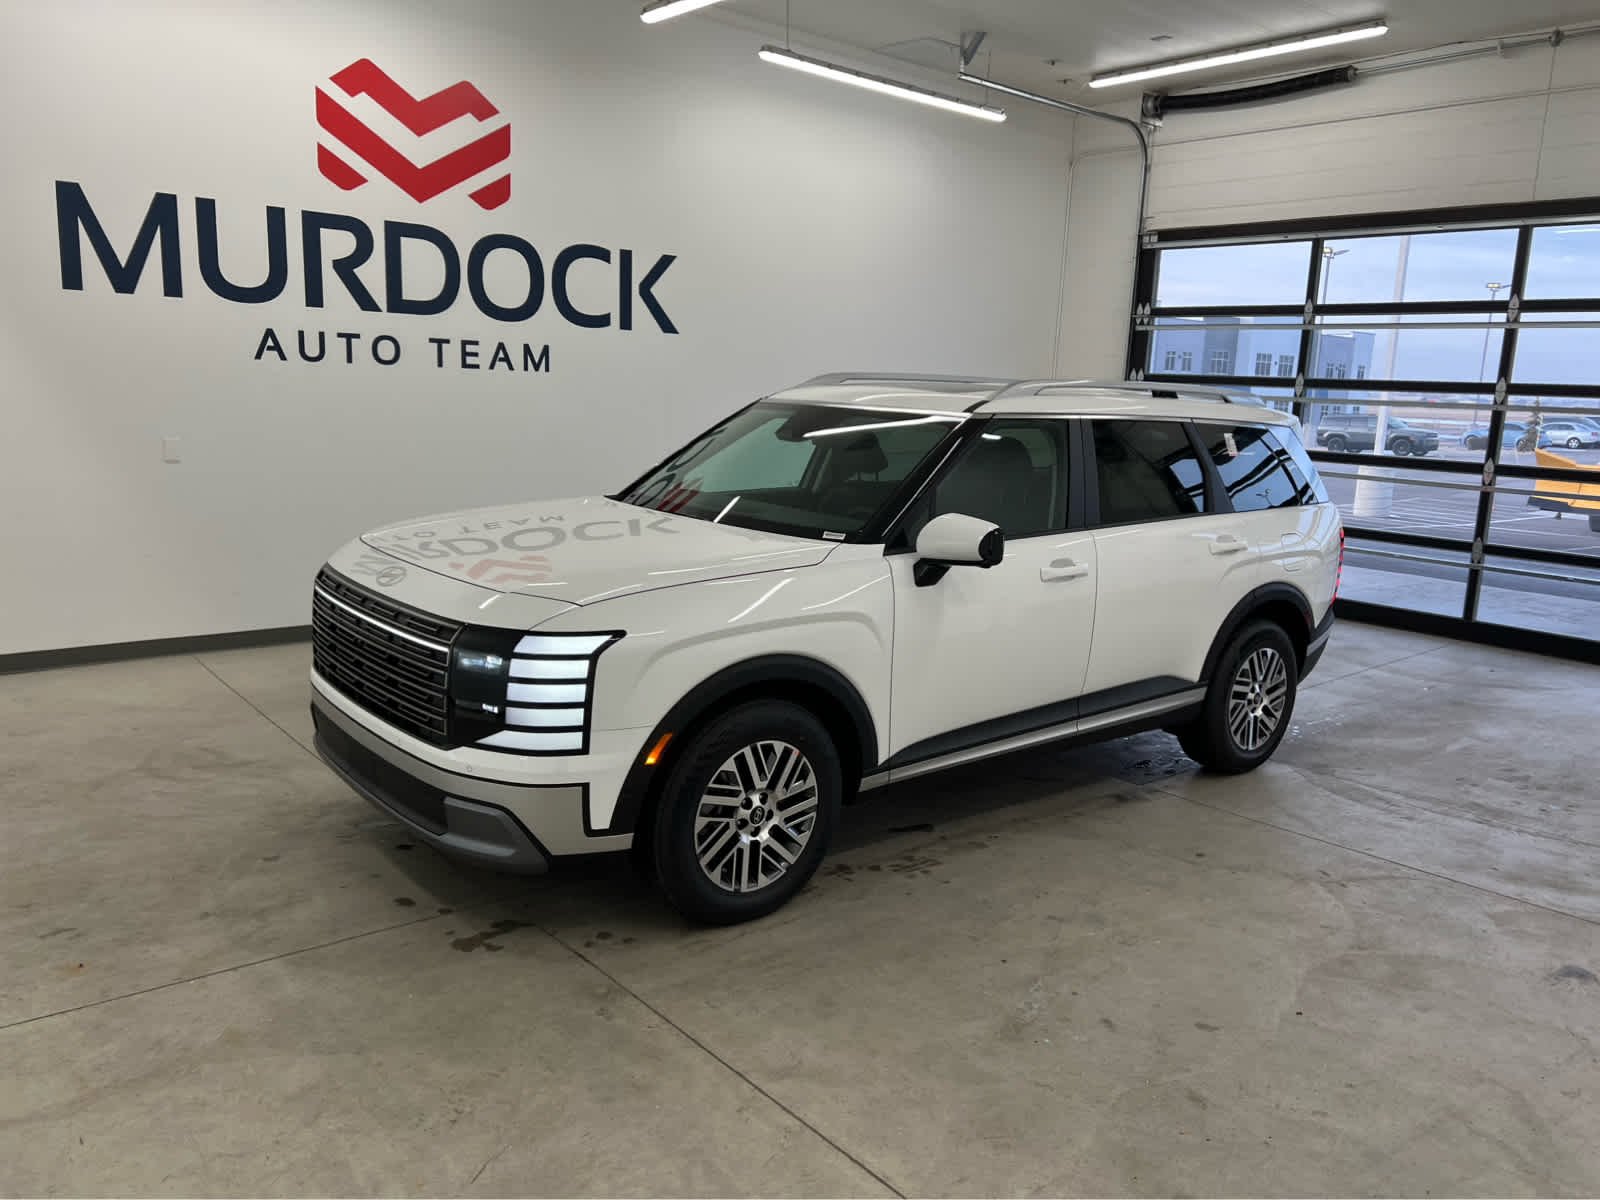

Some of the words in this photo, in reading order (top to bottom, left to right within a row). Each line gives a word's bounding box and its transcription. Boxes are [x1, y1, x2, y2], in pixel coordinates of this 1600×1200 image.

[55, 180, 680, 335] MURDOCK
[253, 327, 402, 366] AUTO
[428, 337, 551, 373] TEAM
